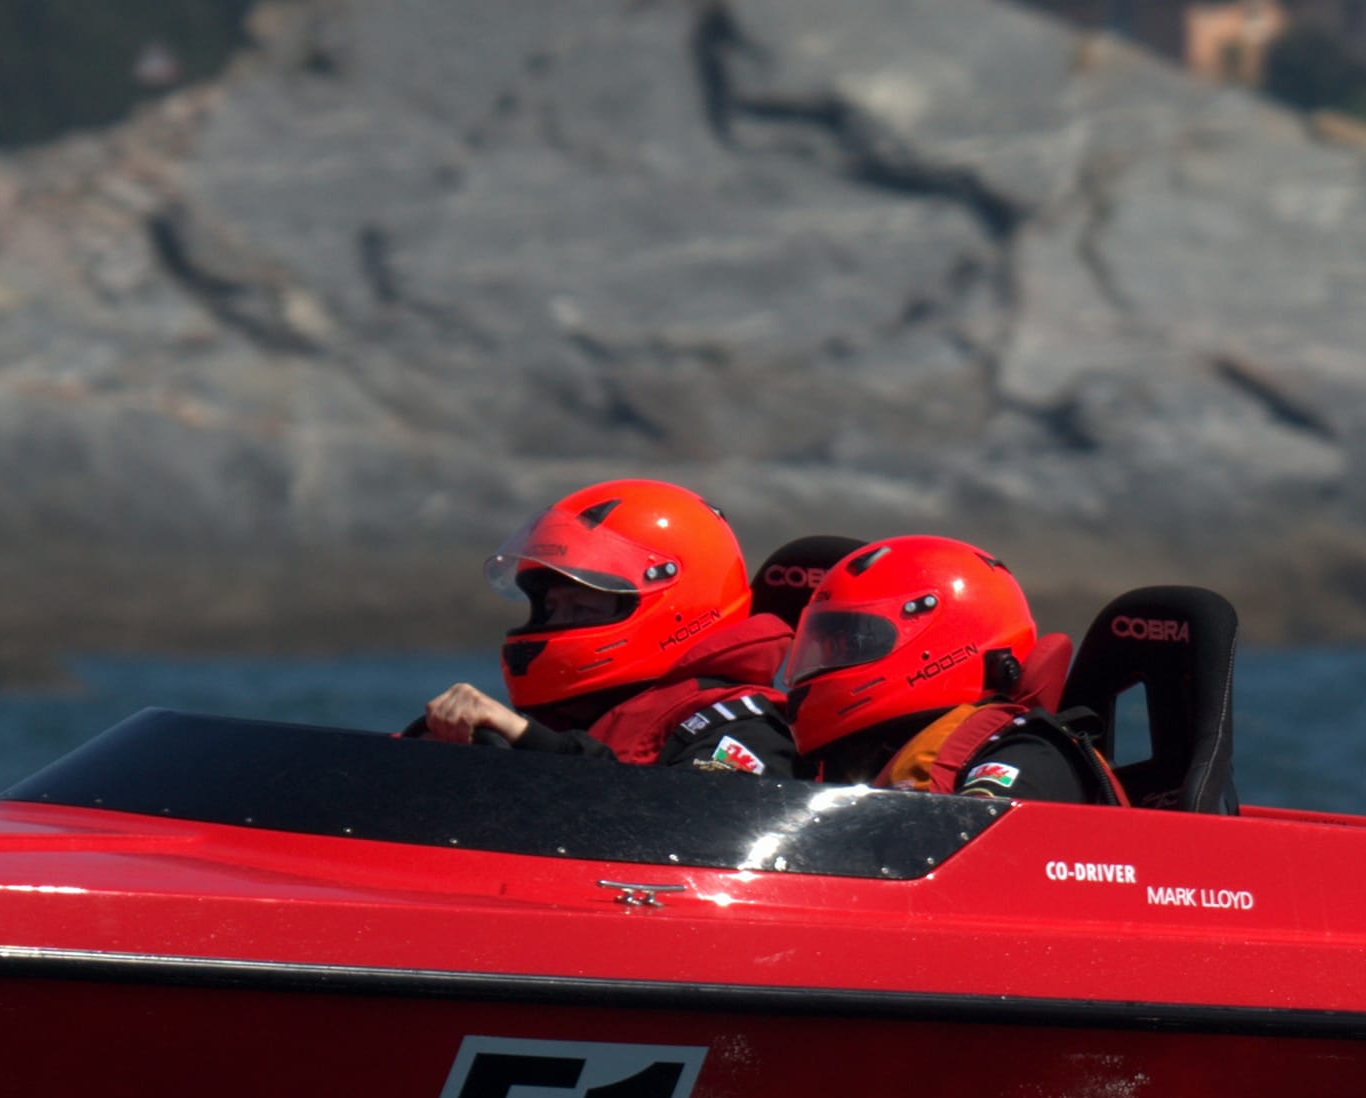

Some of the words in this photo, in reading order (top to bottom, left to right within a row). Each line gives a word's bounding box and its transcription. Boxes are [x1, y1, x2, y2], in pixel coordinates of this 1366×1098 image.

[764, 564, 827, 588] COB
[658, 609, 721, 650] KODEN
[1111, 615, 1190, 643] COBRA
[906, 643, 978, 687] KODEN
[1046, 861, 1136, 883] CO-DRIVER
[1146, 886, 1197, 906] MARK
[1201, 889, 1254, 910] LLOYD
